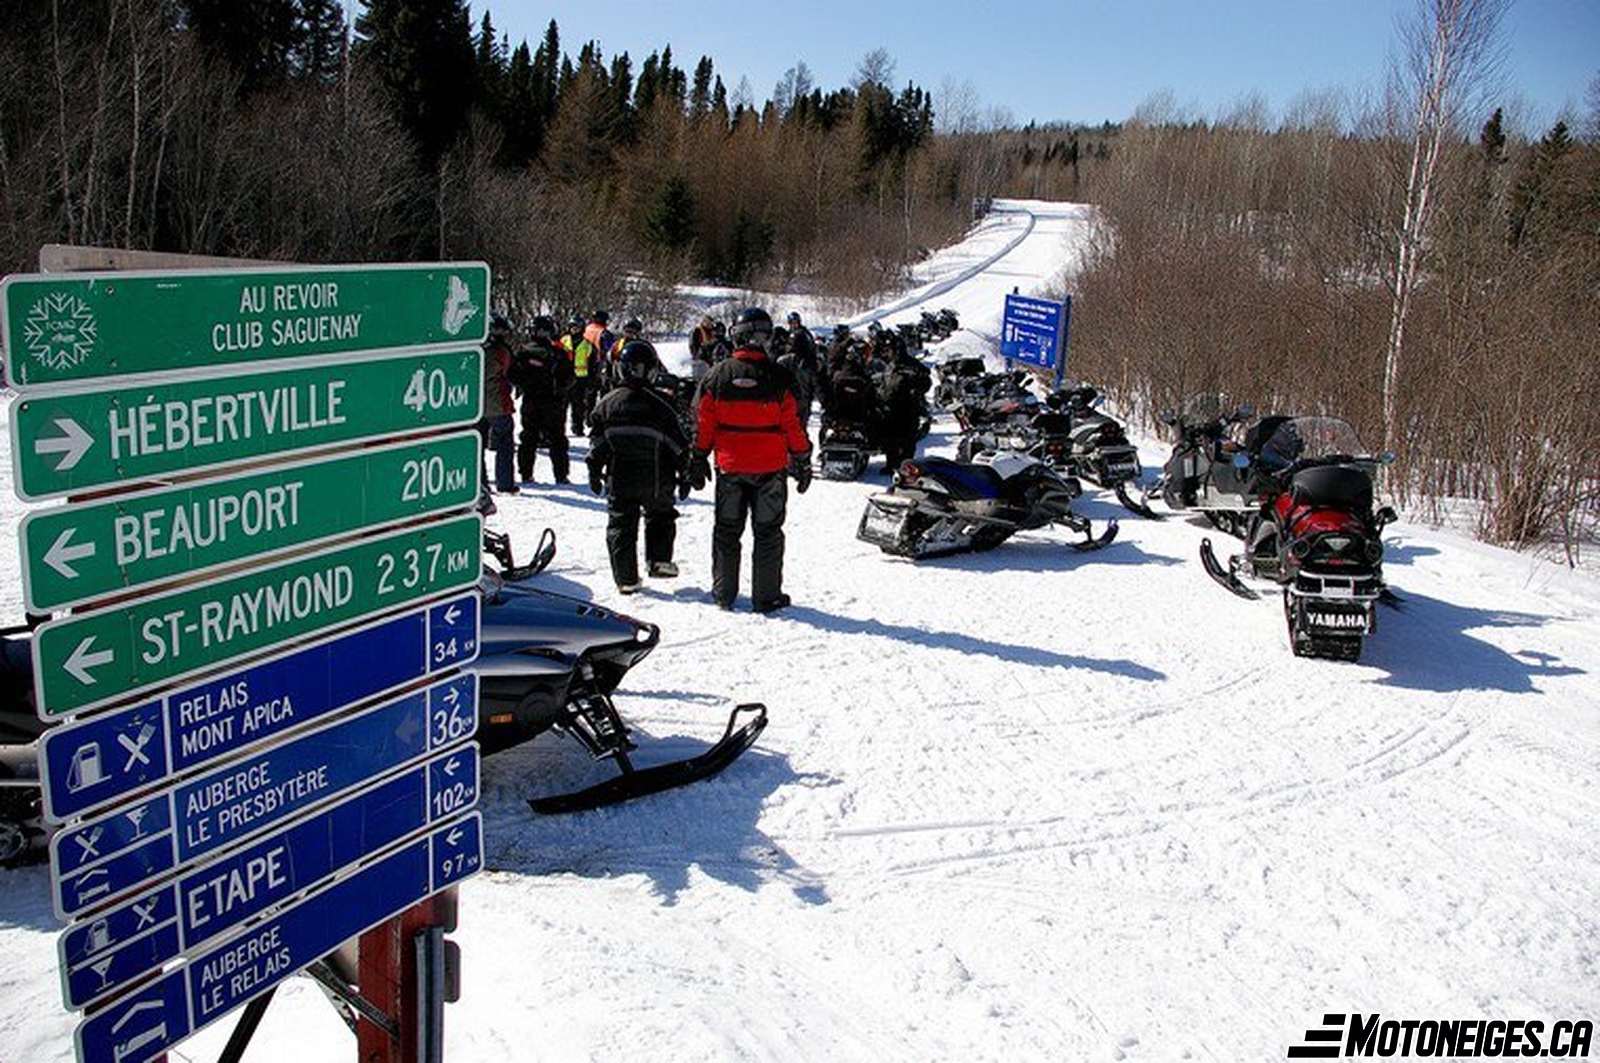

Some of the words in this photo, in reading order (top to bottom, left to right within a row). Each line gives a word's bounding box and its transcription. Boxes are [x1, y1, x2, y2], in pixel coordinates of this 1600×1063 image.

[240, 286, 266, 313] AU
[274, 282, 338, 312] REVOIR
[212, 321, 263, 351] CLUB
[271, 314, 361, 346] SAGUENAY
[109, 381, 346, 459] HÉBERTVILLE
[403, 369, 446, 412] 40
[448, 384, 468, 407] KM
[115, 482, 303, 566] BEAUPORT
[402, 456, 444, 501] 210
[446, 468, 467, 492] KM
[141, 565, 353, 665] ST-RAYMOND
[447, 550, 469, 573] KM
[1307, 612, 1366, 628] YAMAHA
[435, 637, 457, 662] 34
[180, 681, 248, 727] RELAIS
[182, 716, 235, 757] MONT
[242, 696, 293, 734] APICA
[433, 703, 462, 745] 36
[187, 761, 271, 818] AUBERGE
[187, 817, 211, 847] LE
[218, 765, 328, 834] PRESBYTÈRE
[433, 782, 464, 815] 102
[188, 846, 286, 929] ETAPE
[442, 853, 465, 878] 97
[201, 925, 282, 988] AUBERGE
[201, 984, 224, 1015] LE
[231, 947, 291, 998] RELAIS
